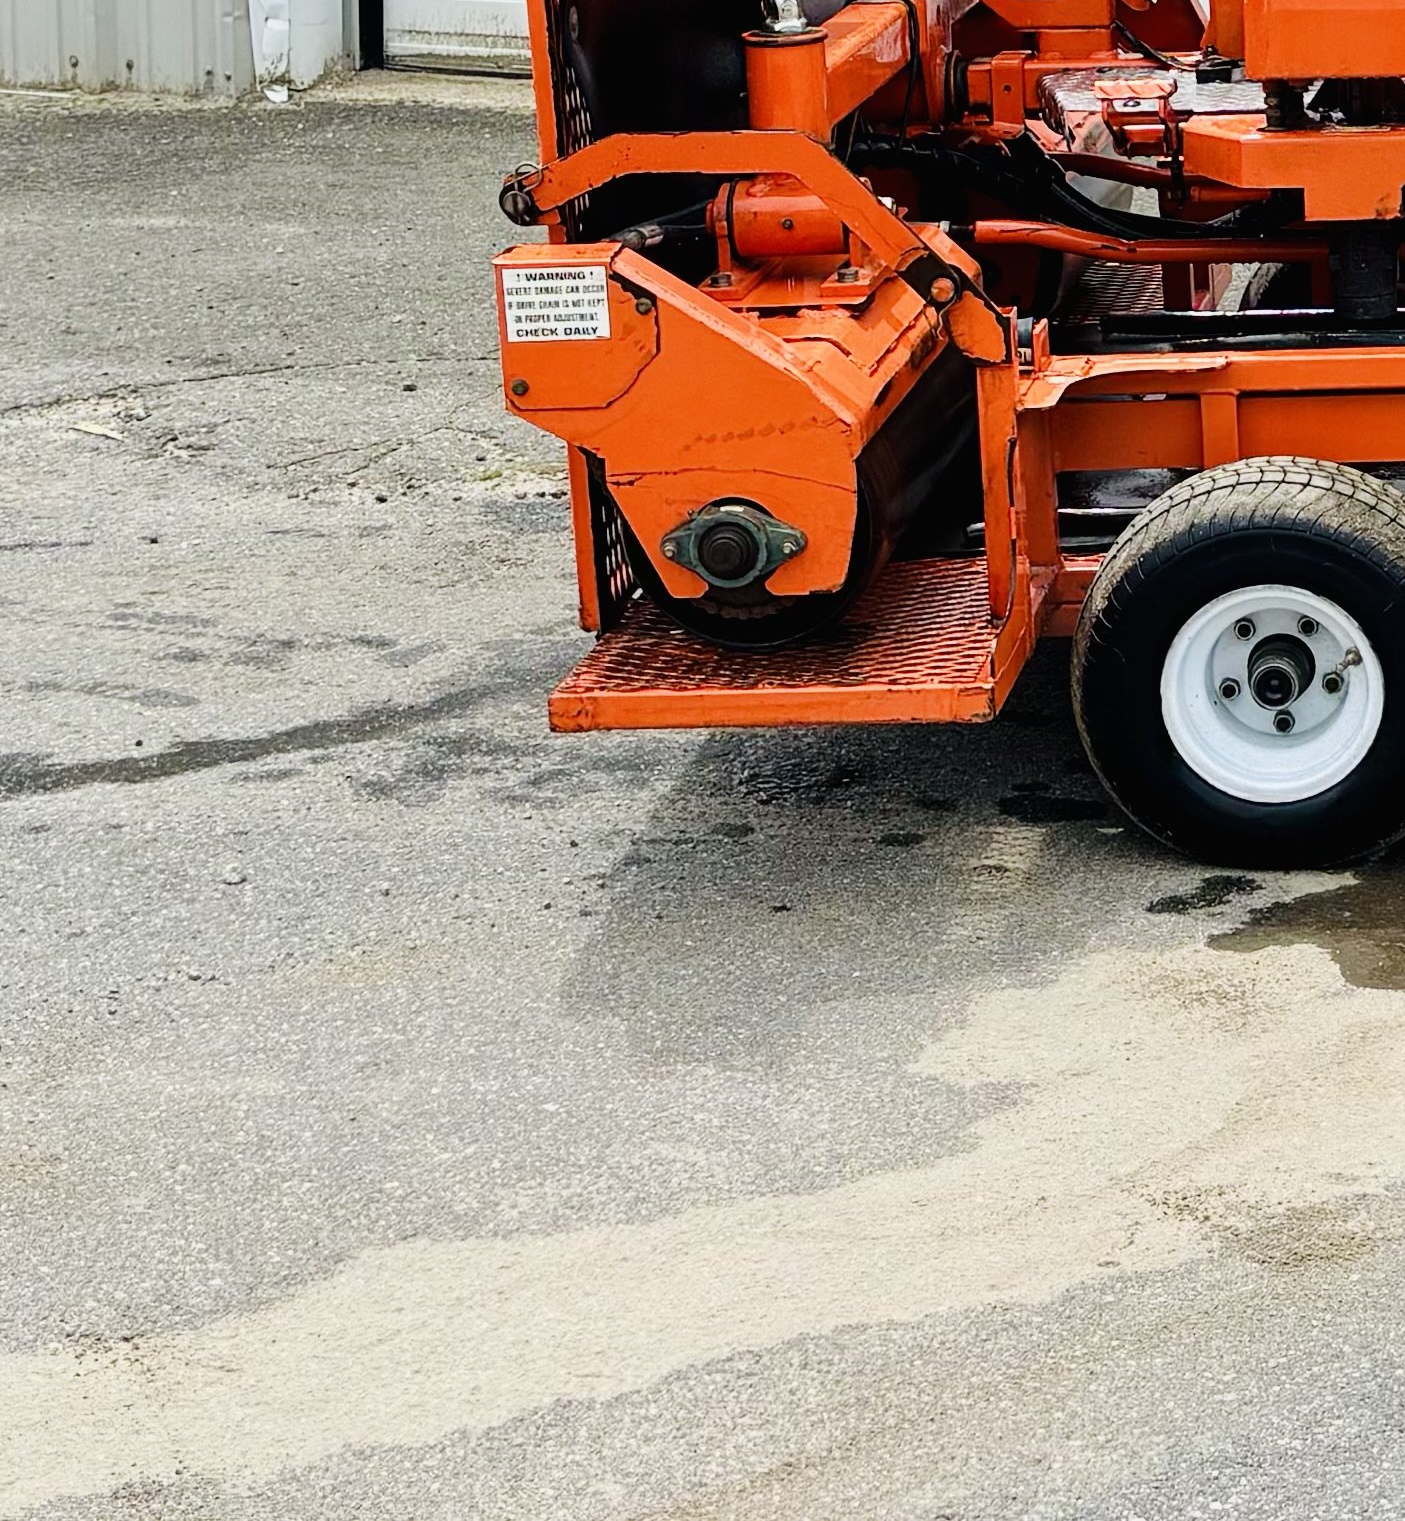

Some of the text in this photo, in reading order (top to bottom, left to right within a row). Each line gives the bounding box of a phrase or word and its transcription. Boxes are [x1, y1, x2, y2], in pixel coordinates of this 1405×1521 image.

[525, 271, 586, 282] WARNING
[566, 285, 580, 294] CAN
[516, 326, 599, 337] CHECK DAILY
